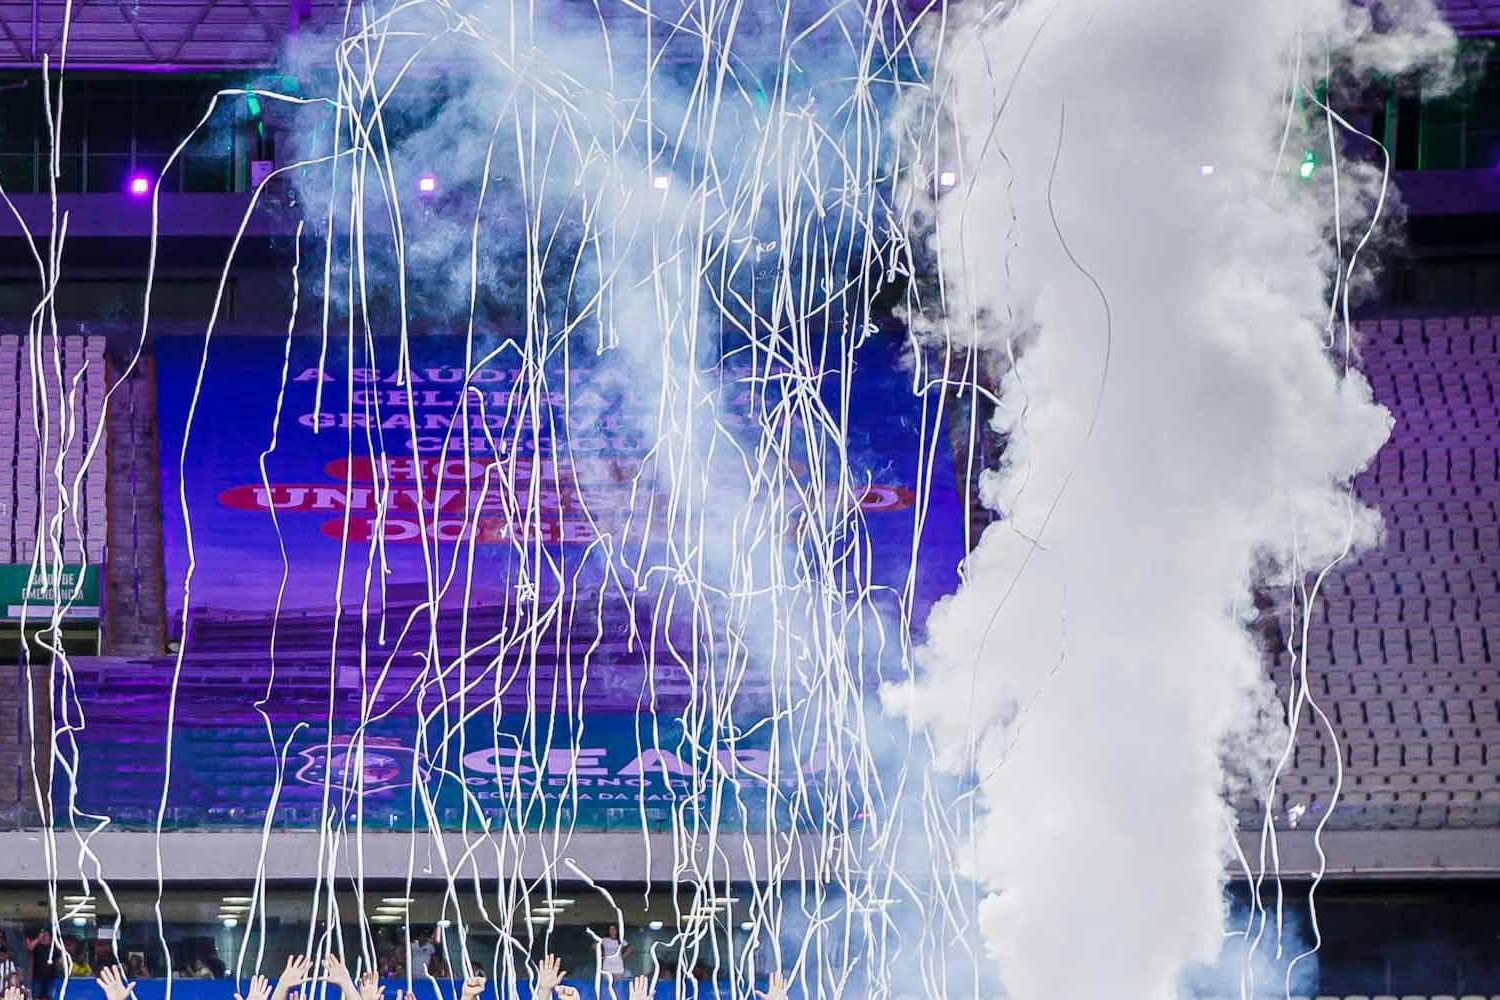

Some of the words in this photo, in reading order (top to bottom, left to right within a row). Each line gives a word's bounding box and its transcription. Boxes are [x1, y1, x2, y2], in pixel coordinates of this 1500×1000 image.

[293, 367, 336, 382] A
[297, 413, 543, 428] GRANDE
[366, 519, 482, 540] DO
[464, 777, 654, 787] GOVERNO
[597, 792, 629, 801] DA
